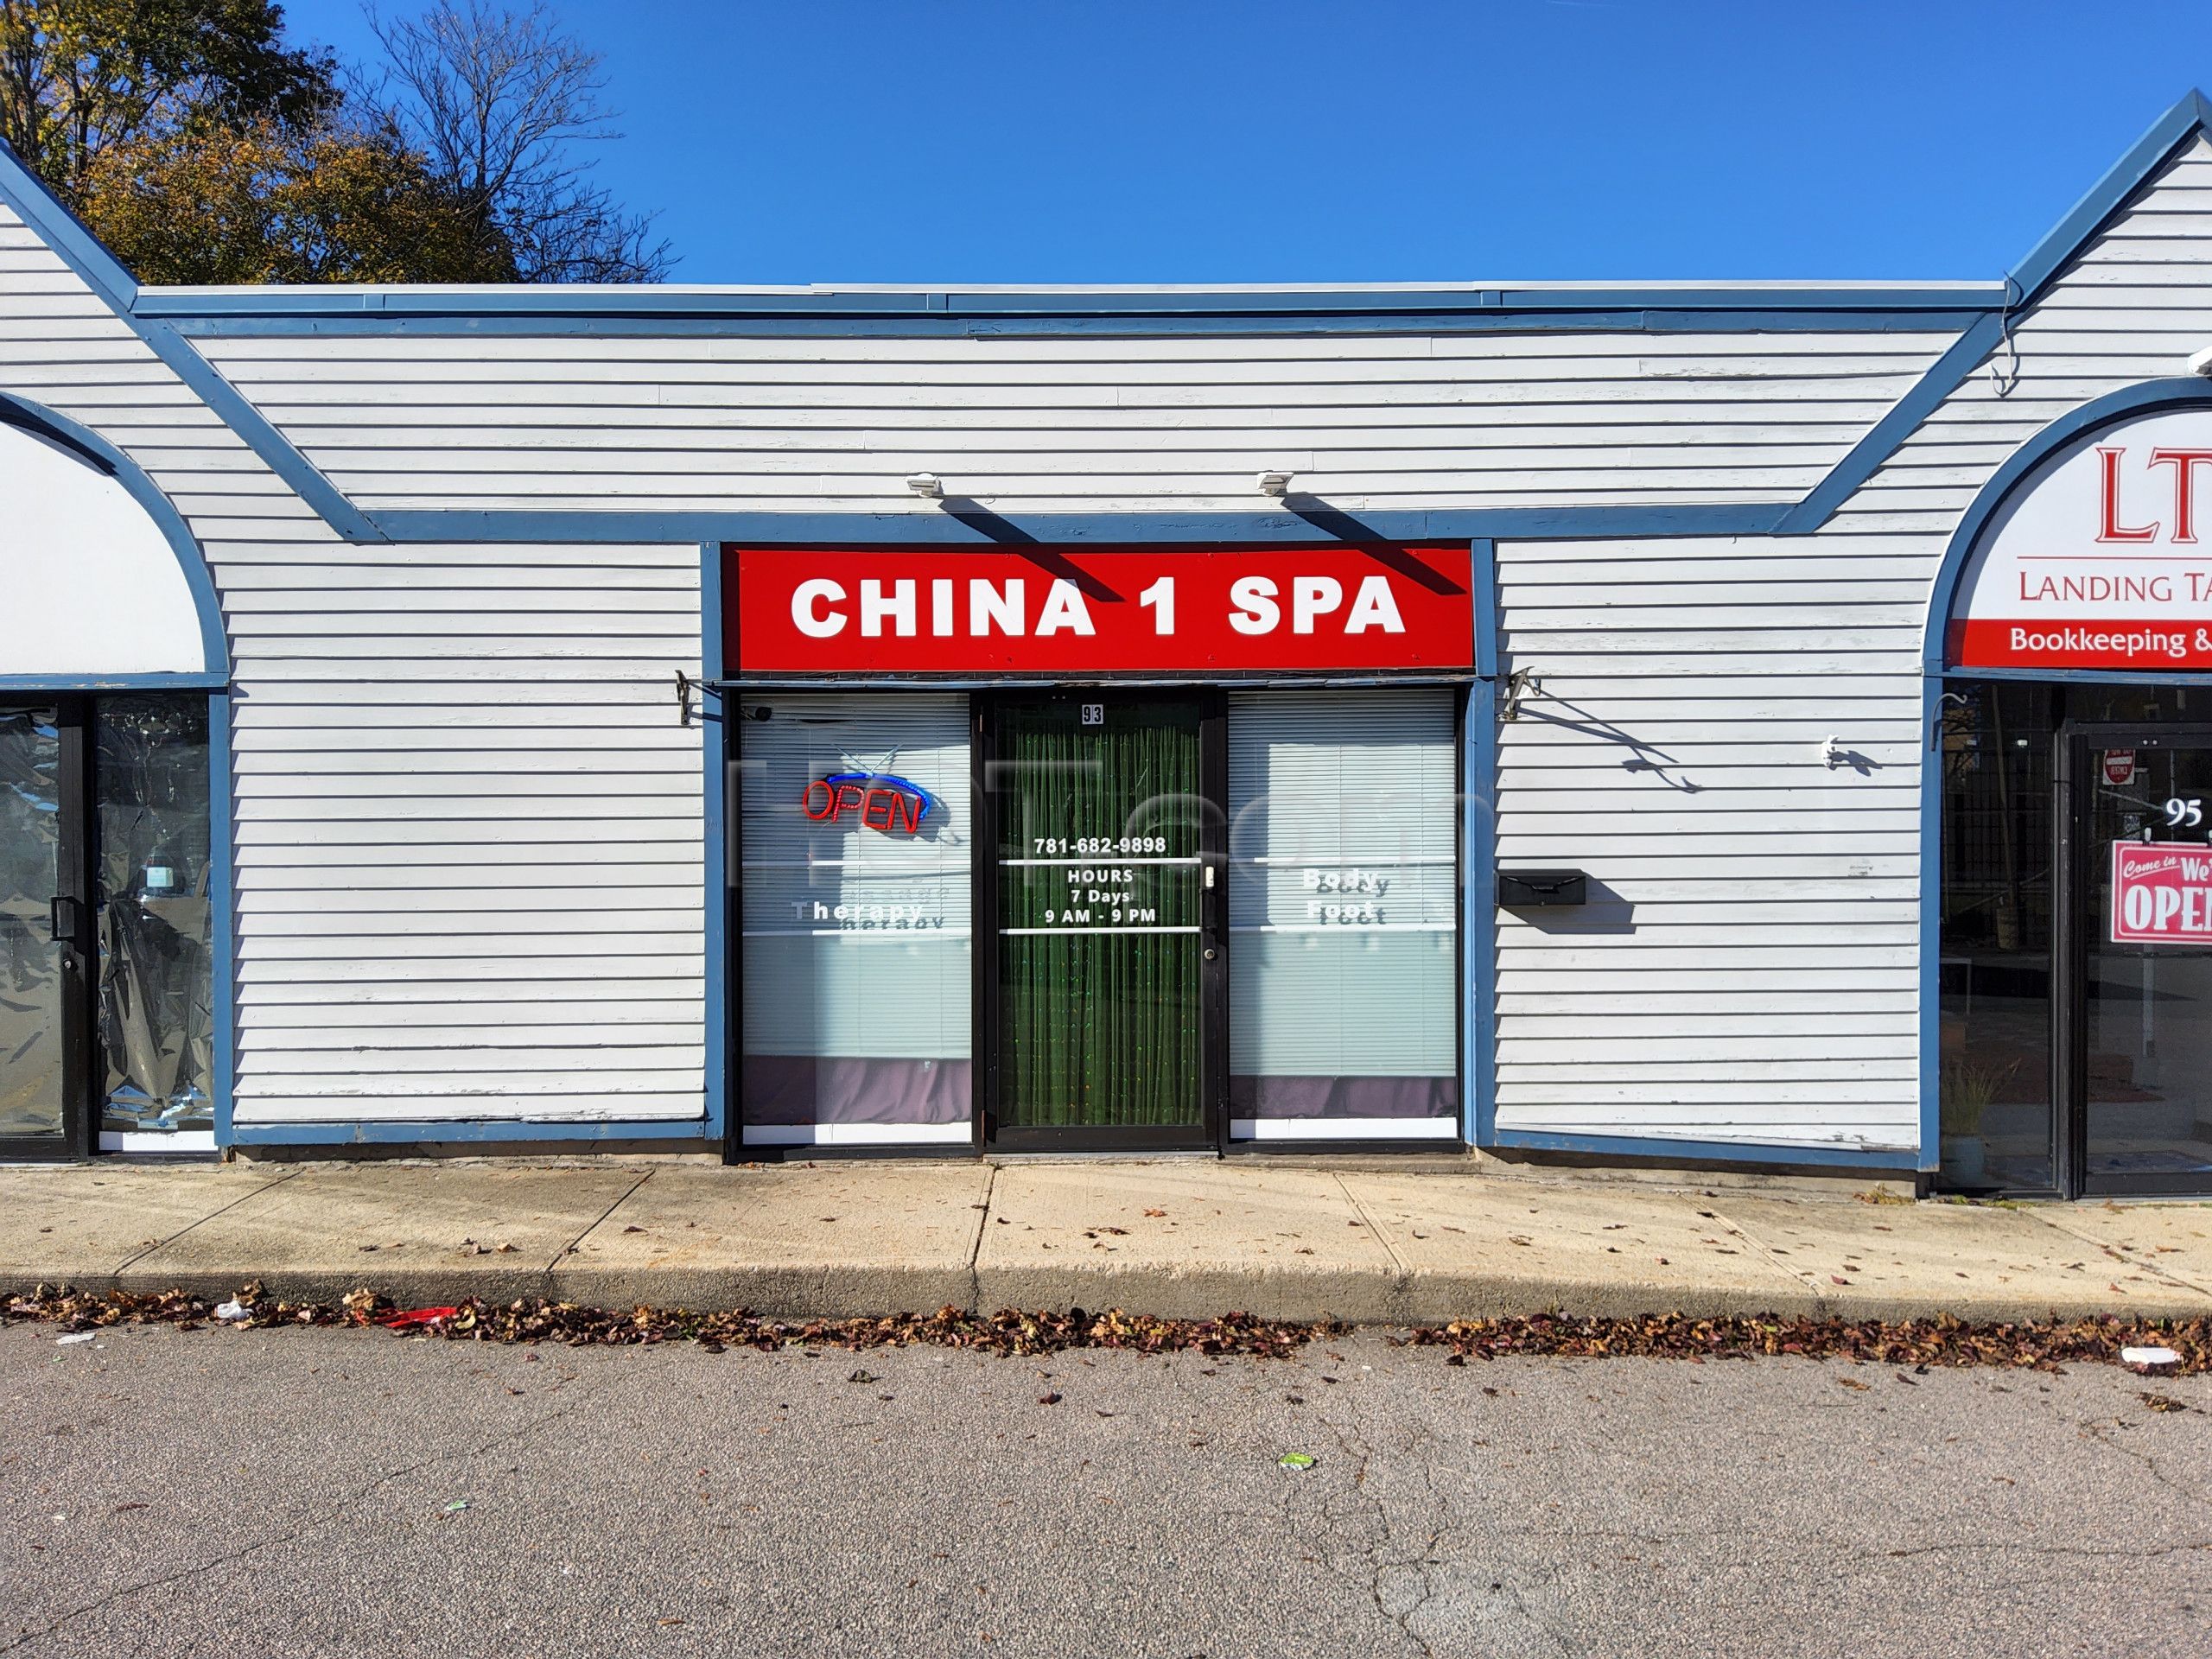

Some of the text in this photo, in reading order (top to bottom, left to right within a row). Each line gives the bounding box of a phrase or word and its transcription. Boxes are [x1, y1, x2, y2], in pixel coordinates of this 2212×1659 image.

[2019, 571, 2172, 601] LANDING
[791, 575, 1406, 638] CHINA 1 SPA
[2010, 627, 2187, 658] Bookkeeping
[1083, 705, 1102, 722] 93
[802, 780, 922, 834] OPEN
[2166, 798, 2202, 827] 95
[1034, 836, 1166, 854] 781-682-9898
[1068, 868, 1134, 883] HOURS
[2123, 860, 2160, 878] Come
[2163, 855, 2177, 867] in
[1303, 868, 1378, 893] Body
[1071, 889, 1130, 906] 7 Days
[1306, 899, 1375, 918] Foot
[791, 900, 925, 923] Therapy
[1045, 910, 1055, 923] 9
[1062, 910, 1090, 923] AM
[1112, 909, 1122, 922] 9
[1129, 908, 1155, 922] PM
